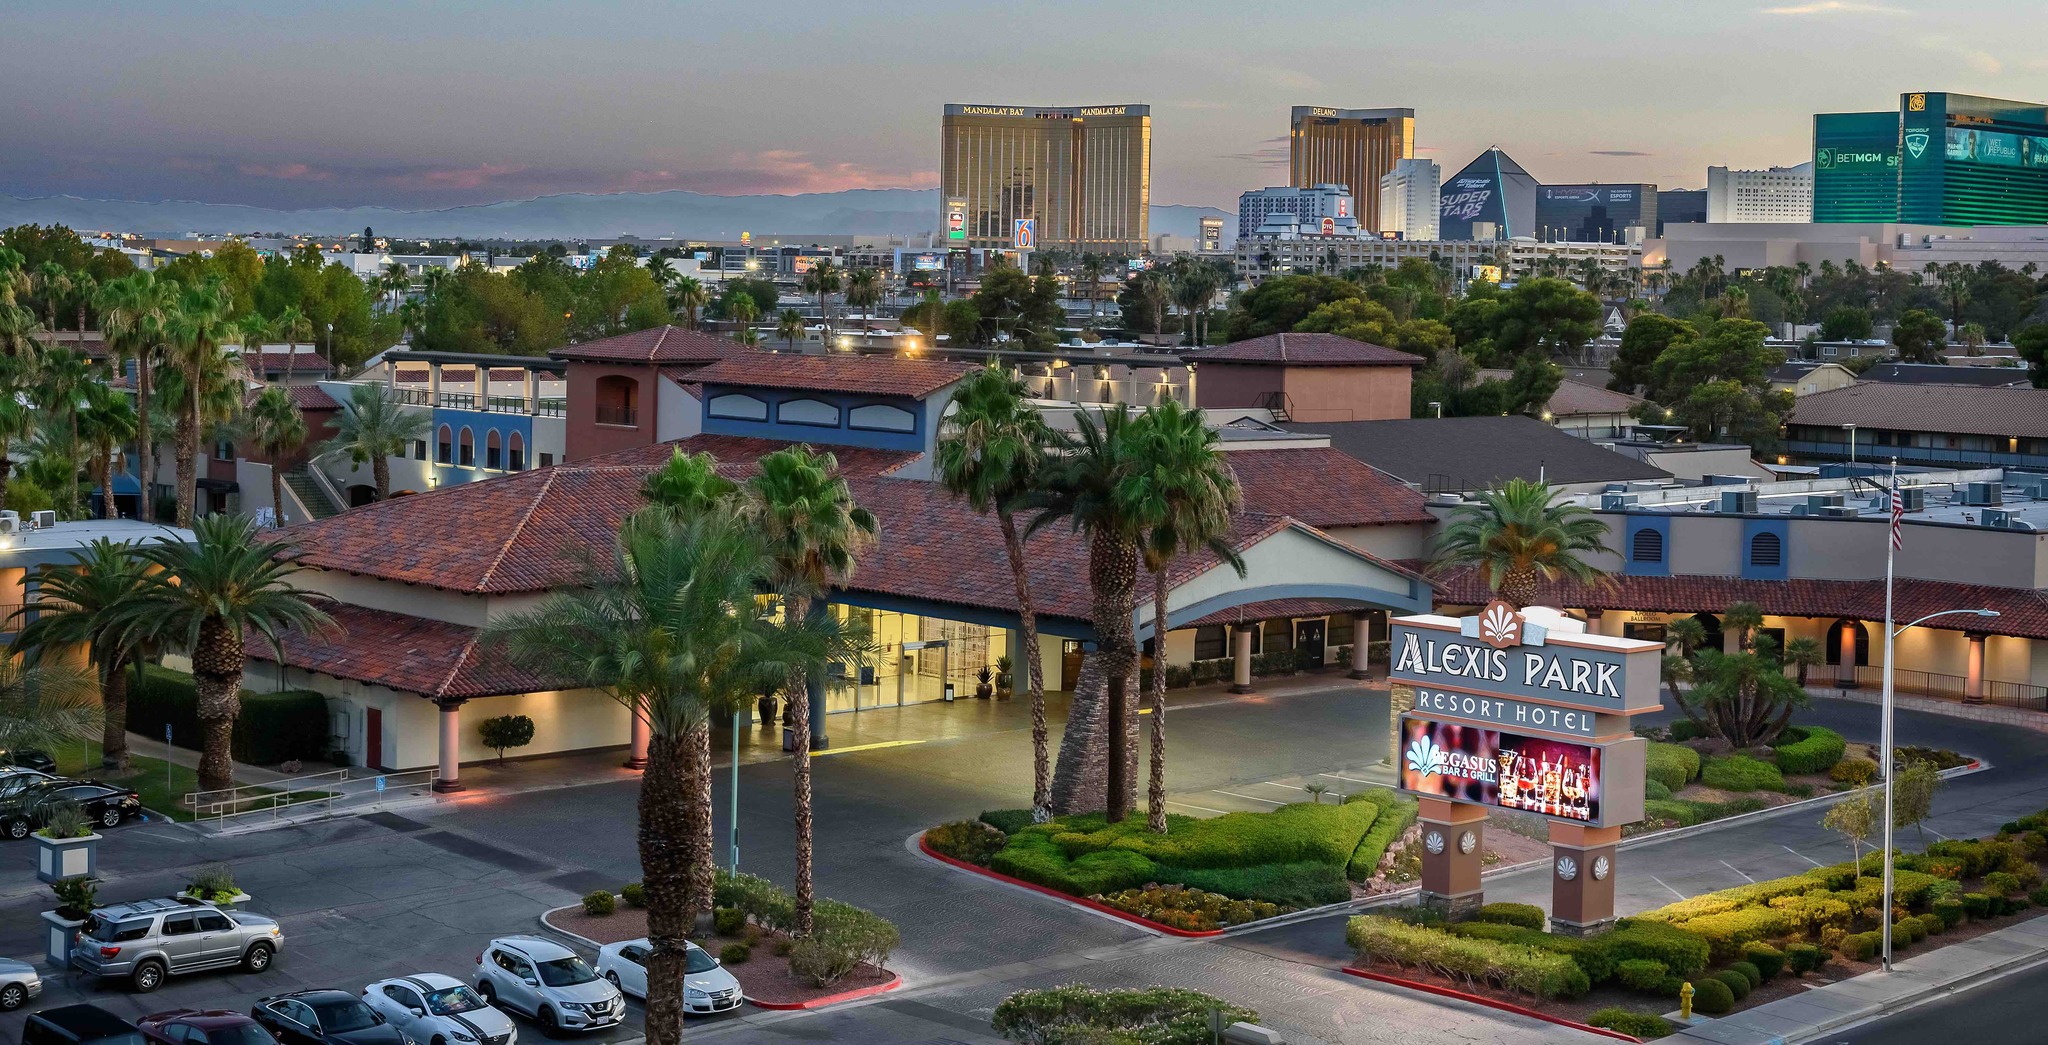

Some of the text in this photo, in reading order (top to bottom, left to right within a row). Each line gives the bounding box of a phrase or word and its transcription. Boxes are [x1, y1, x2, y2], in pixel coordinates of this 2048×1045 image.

[963, 106, 1025, 116] MANDALAY BAY
[1080, 106, 1127, 115] MANDALAY BAY
[1313, 107, 1337, 117] DELANO
[1837, 153, 1881, 163] BETMGM
[1989, 146, 2016, 155] REPUBLIC
[1440, 190, 1491, 206] SUPER
[1440, 201, 1484, 217] TARS
[1017, 220, 1031, 247] 6
[1395, 632, 1622, 699] ALEXIS PARK
[1420, 690, 1591, 732] RESORT HOTEL
[1432, 751, 1497, 774] PEGASUS
[1442, 765, 1496, 783] BAR & GRILL
